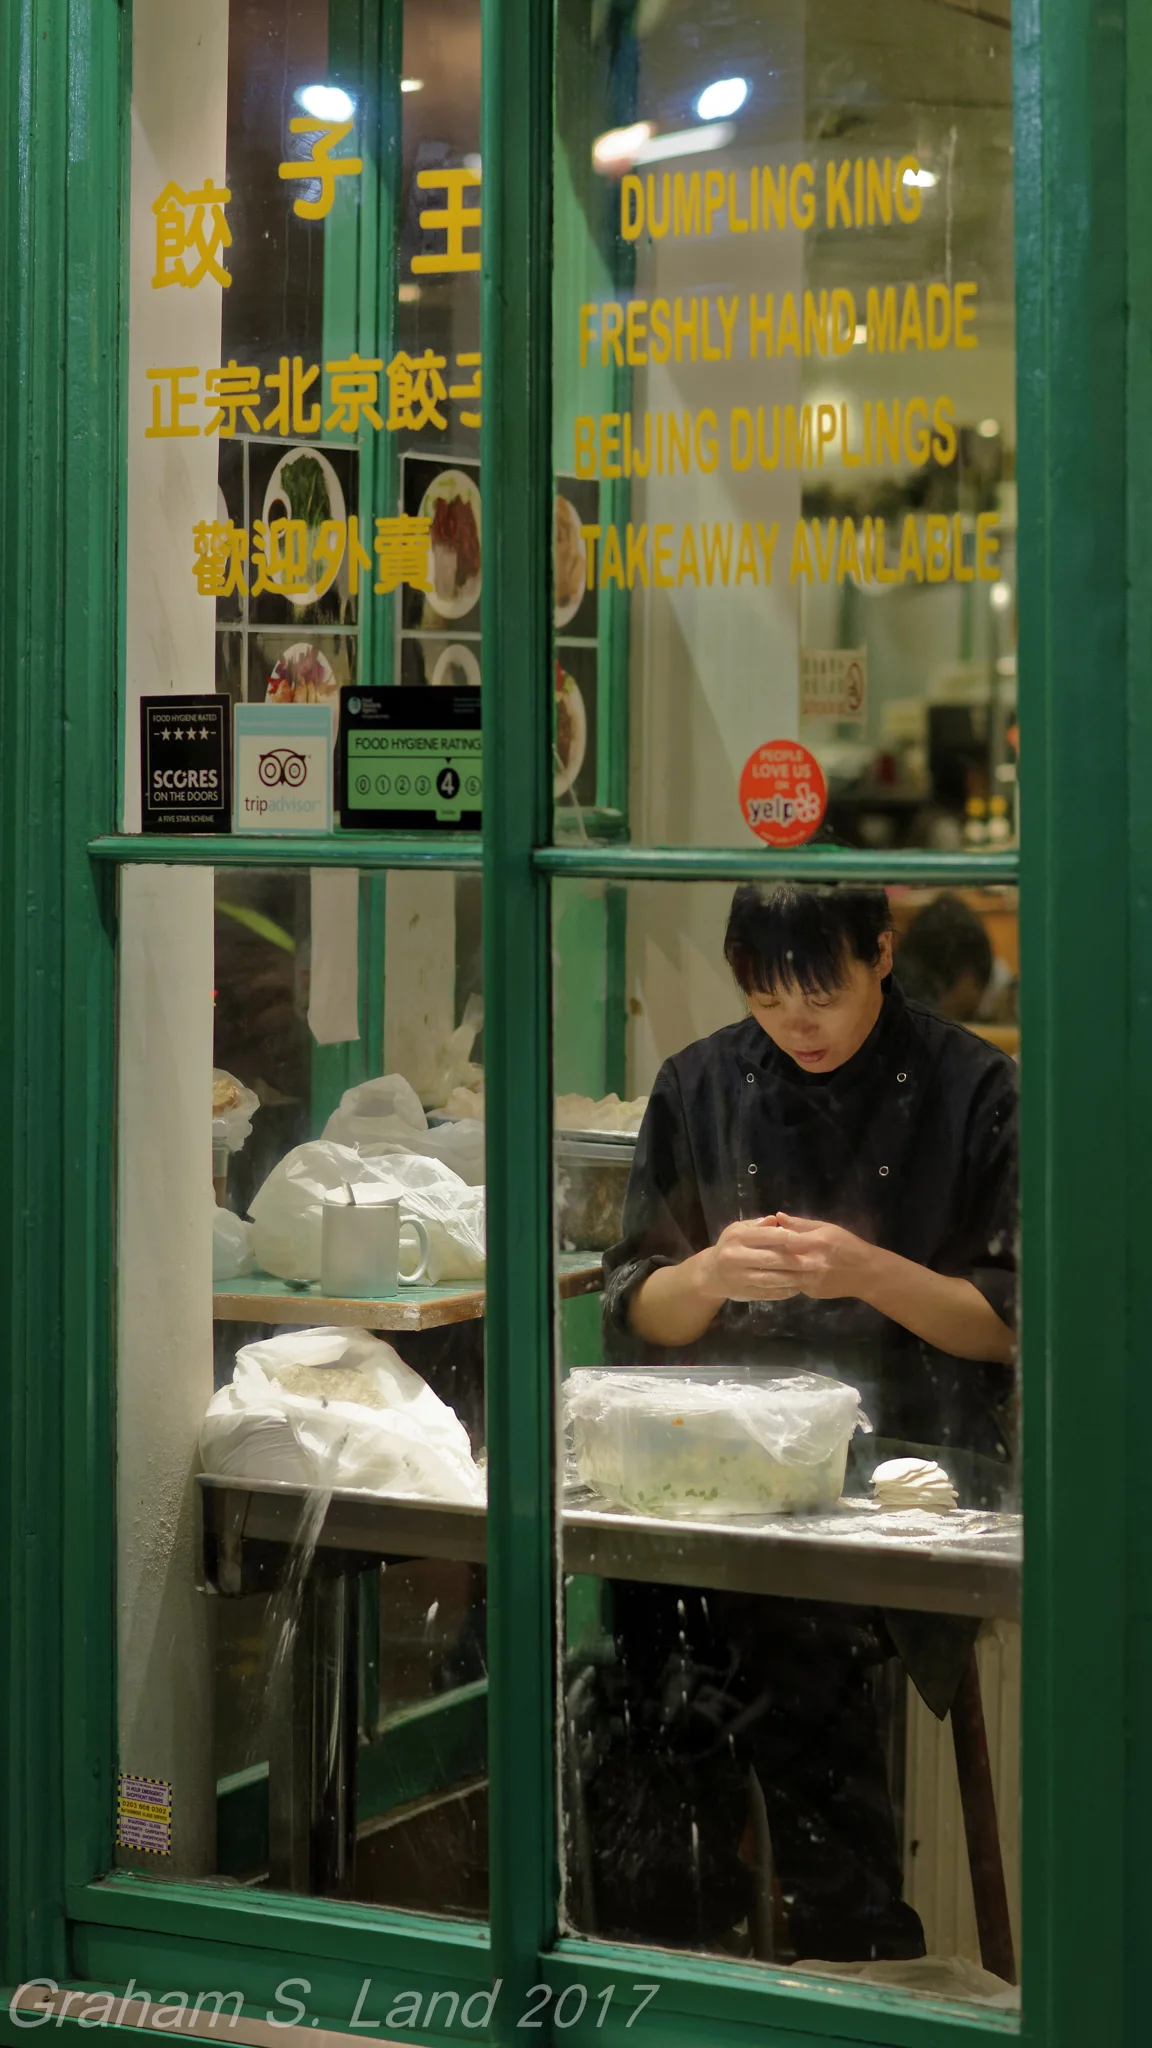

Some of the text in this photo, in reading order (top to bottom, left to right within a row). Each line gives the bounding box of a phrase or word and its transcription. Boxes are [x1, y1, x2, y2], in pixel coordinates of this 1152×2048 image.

[621, 155, 922, 241] DUMPLING KING
[579, 281, 979, 368] FRESHLY HAND MADE
[574, 396, 958, 480] BEIJING DUMPLINGS
[191, 513, 434, 597] 歡迎外賣
[579, 511, 1001, 592] TAKEAWAY AVAILABLE
[153, 713, 217, 722] FOOD HYGIENE RATED
[355, 737, 482, 751] FOOD HYGIENE RATING
[153, 769, 218, 789] SCORES
[752, 763, 812, 779] LOVE US
[440, 771, 455, 796] 4
[153, 790, 219, 802] ON THE DOORS
[244, 795, 318, 816] tripadvisor
[158, 815, 214, 823] A FIVE STAR SCHEME
[749, 796, 794, 824] yelp
[122, 1800, 137, 1809] 0203
[151, 1806, 167, 1815] 0302
